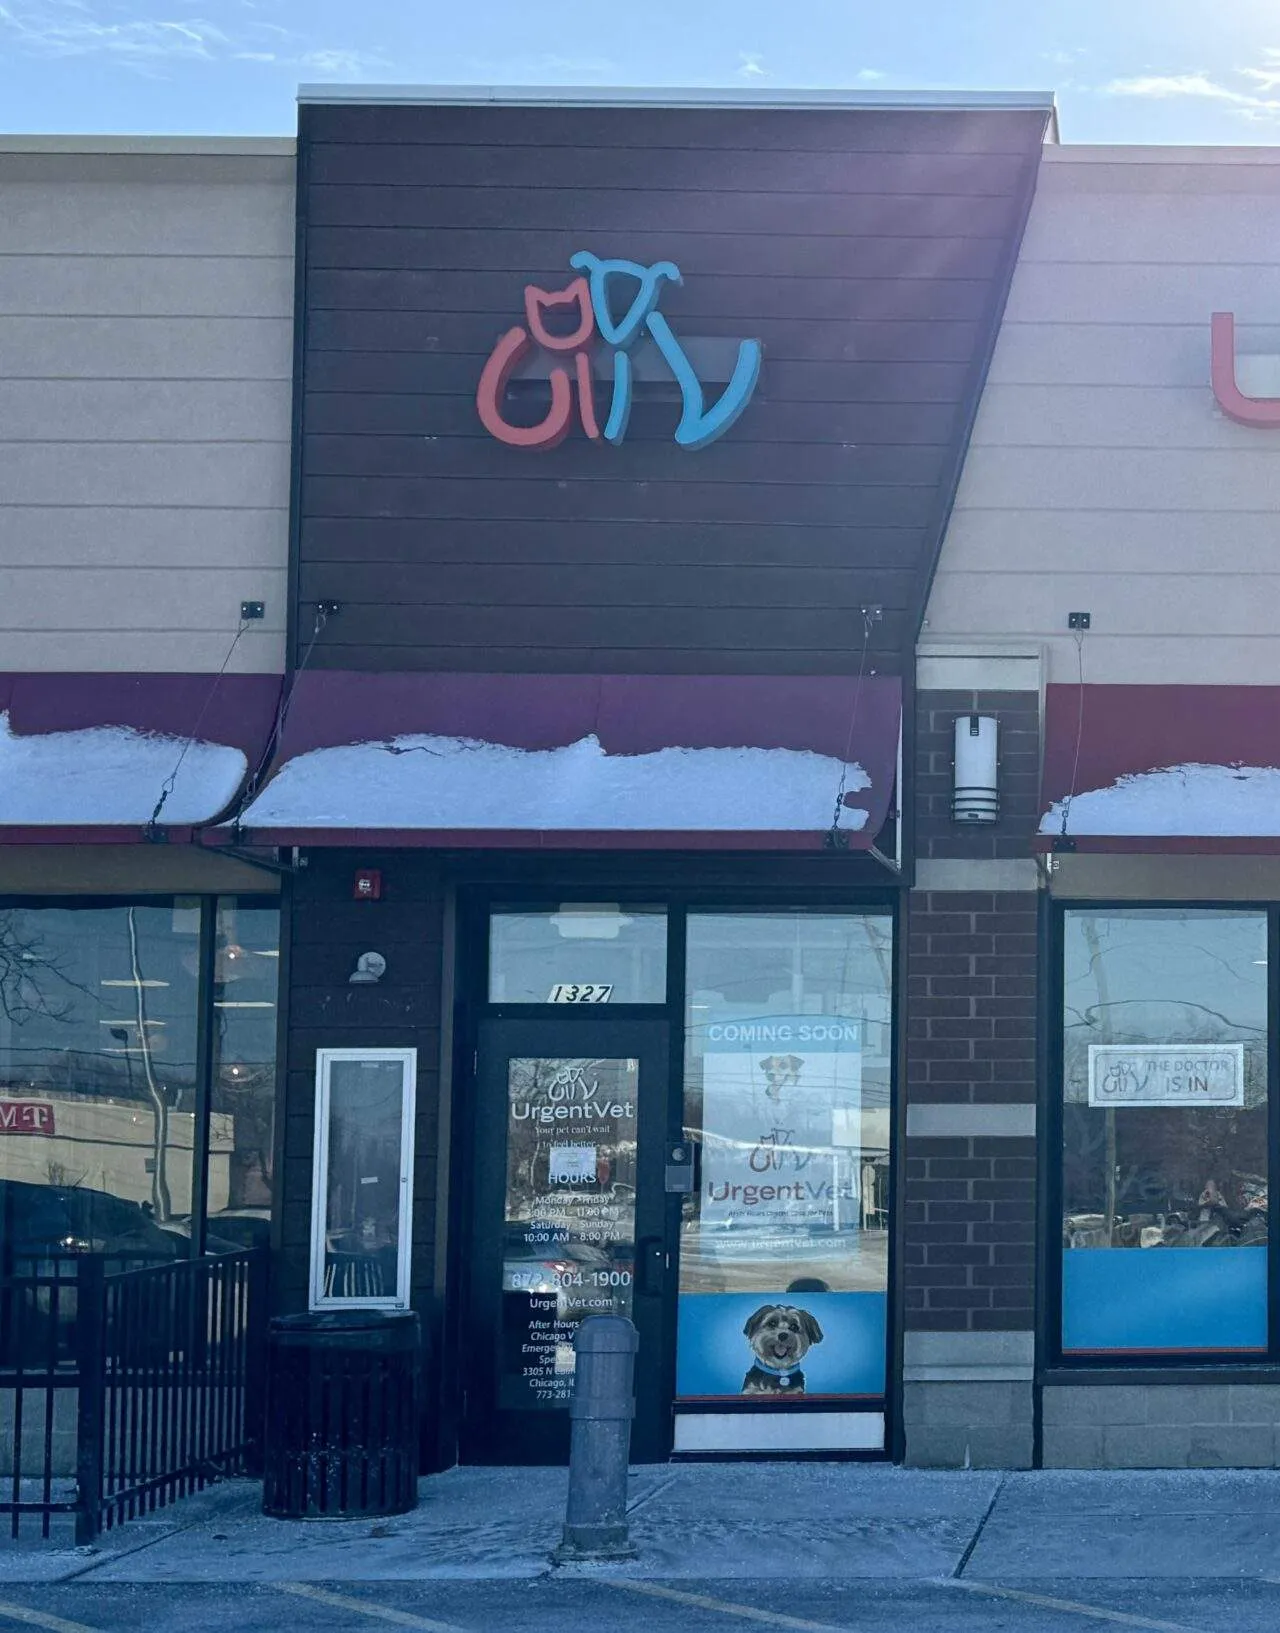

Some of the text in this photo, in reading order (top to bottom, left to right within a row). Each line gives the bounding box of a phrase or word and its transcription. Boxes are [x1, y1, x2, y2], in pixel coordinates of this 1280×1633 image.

[554, 985, 611, 1002] 1327
[709, 1025, 858, 1041] COMING SOON
[1147, 1060, 1229, 1071] THE DOCTOR
[1166, 1077, 1209, 1092] IS IN
[511, 1101, 634, 1123] UrgentVet
[556, 1126, 569, 1135] pet
[593, 1125, 610, 1133] wait
[548, 1173, 597, 1184] HOURS
[708, 1180, 856, 1205] UrgentVet
[535, 1196, 573, 1206] Monday
[550, 1208, 566, 1217] PM
[530, 1221, 571, 1231] Saturday
[581, 1220, 614, 1230] Sunday
[524, 1233, 549, 1243] 10:00
[552, 1232, 570, 1242] AM
[580, 1232, 601, 1241] 8:00
[604, 1231, 620, 1241] PM
[529, 1320, 580, 1329] After Hours
[531, 1332, 566, 1342] Chicago
[523, 1367, 544, 1376] 3305
[546, 1367, 552, 1375] N
[529, 1378, 567, 1388] Chicago,
